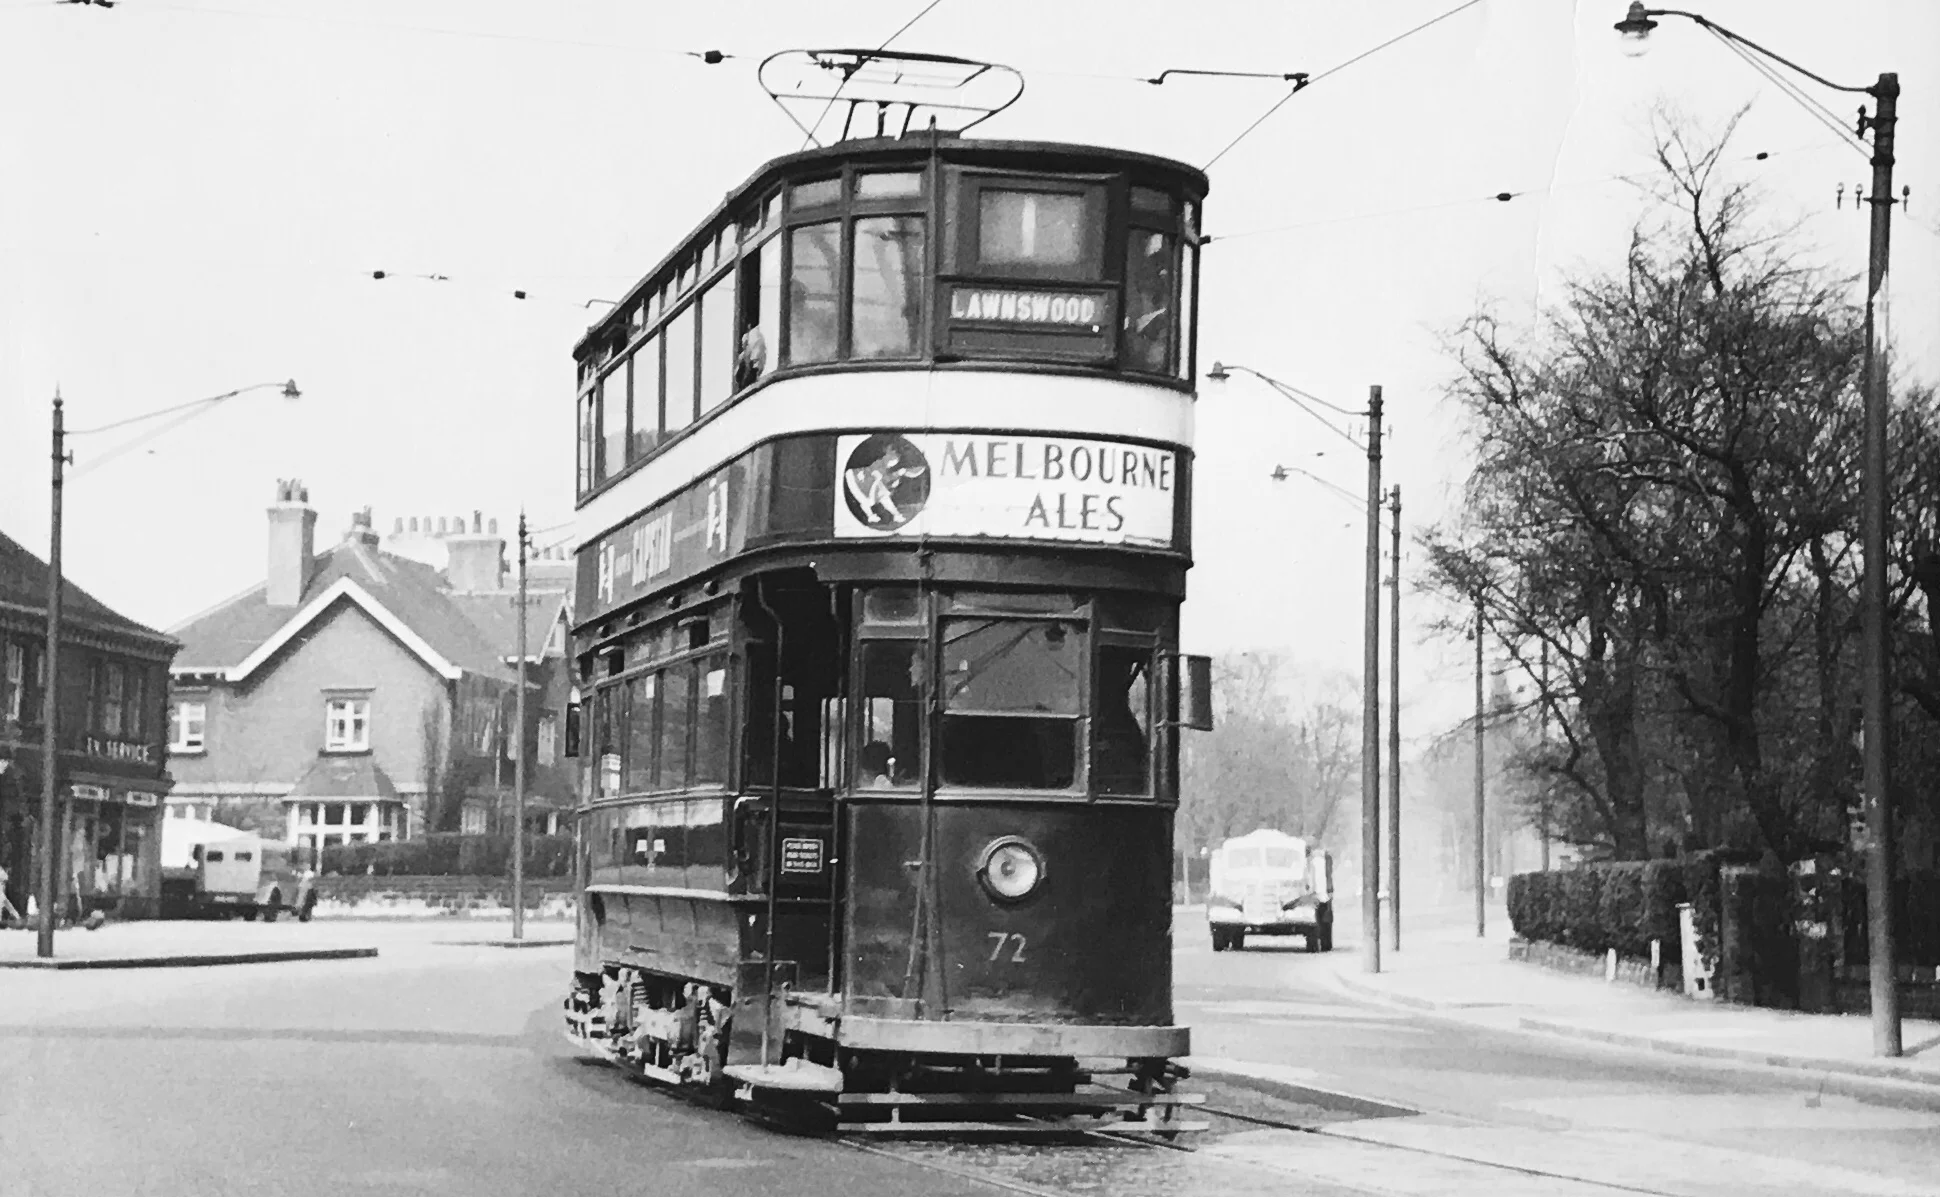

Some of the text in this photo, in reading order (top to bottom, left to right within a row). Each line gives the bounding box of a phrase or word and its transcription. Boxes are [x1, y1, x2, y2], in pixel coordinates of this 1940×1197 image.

[951, 290, 1096, 323] LAWNSWOOD
[940, 440, 1174, 491] MELBOURNE
[1024, 492, 1125, 532] ALES
[988, 931, 1027, 963] 72
